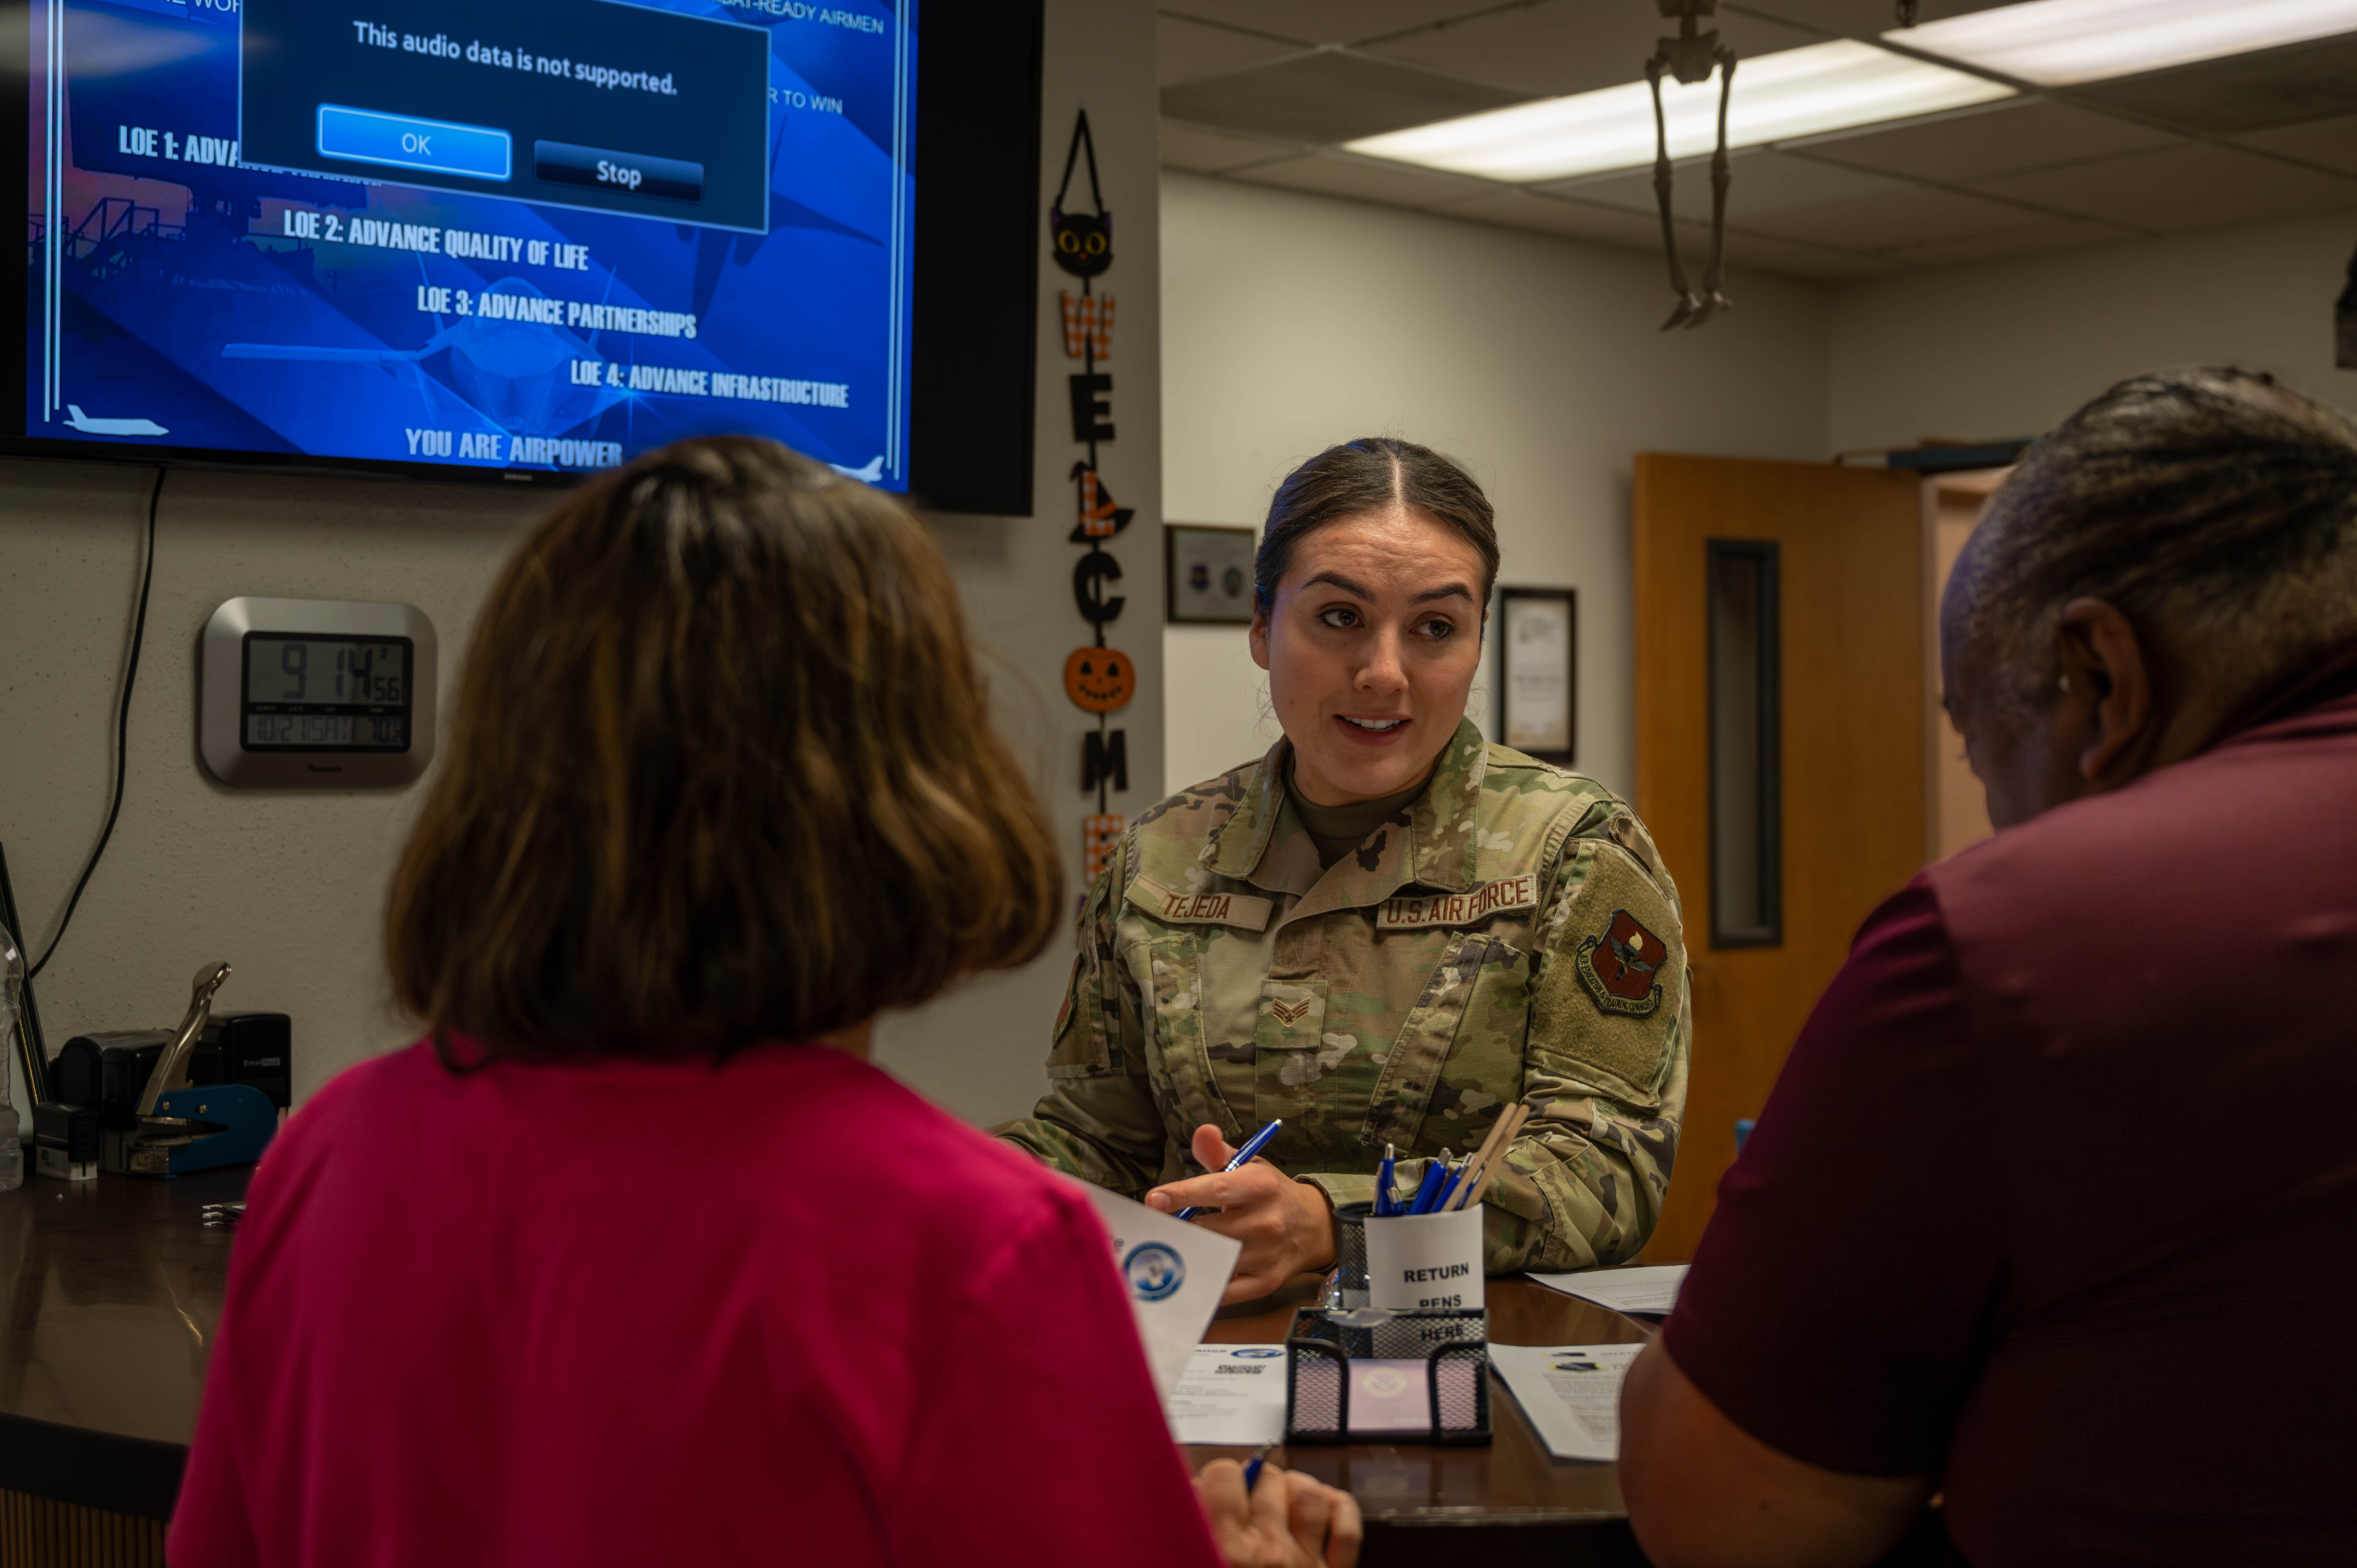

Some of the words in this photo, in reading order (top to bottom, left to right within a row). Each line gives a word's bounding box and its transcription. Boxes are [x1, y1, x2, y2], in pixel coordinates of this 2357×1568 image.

[818, 8, 884, 35] AIRMEN
[352, 20, 398, 49] This
[402, 33, 461, 59] audio
[466, 40, 513, 68] data
[517, 47, 533, 71] is
[536, 55, 571, 78] not
[574, 62, 678, 96] supported.
[782, 90, 806, 108] TO
[809, 94, 843, 115] WIN
[119, 125, 158, 157] LOE
[163, 131, 179, 160] 1:
[402, 133, 431, 155] OK
[597, 161, 642, 190] Stop
[284, 209, 321, 240] LOE
[324, 214, 344, 242] 2:
[348, 217, 441, 254] ADVANCE
[445, 228, 523, 263] QUALITY
[527, 238, 550, 266] OF
[554, 242, 590, 271] LIFE
[417, 284, 452, 314] LOE
[455, 289, 474, 316] 3:
[477, 292, 565, 326] ADVANCE
[567, 301, 697, 339] PARTNERSHIPS
[571, 359, 603, 387] LOE
[606, 362, 625, 388] 4:
[629, 364, 709, 396] ADVANCE
[711, 371, 850, 409] INFRASTRUCTURE
[405, 427, 452, 458] YOU
[458, 432, 503, 461] ARE
[509, 435, 623, 467] AIRPOWER
[1163, 893, 1231, 919] TEJEDA
[1387, 900, 1425, 923] U.S.
[1428, 897, 1464, 921] AIR
[1468, 879, 1529, 919] FORCE
[1580, 955, 1589, 966] AIR
[1582, 966, 1604, 993] EDUCATION
[1603, 997, 1630, 1009] TRAINING
[1404, 1262, 1468, 1283] RETURN
[1419, 1294, 1461, 1307] PENS
